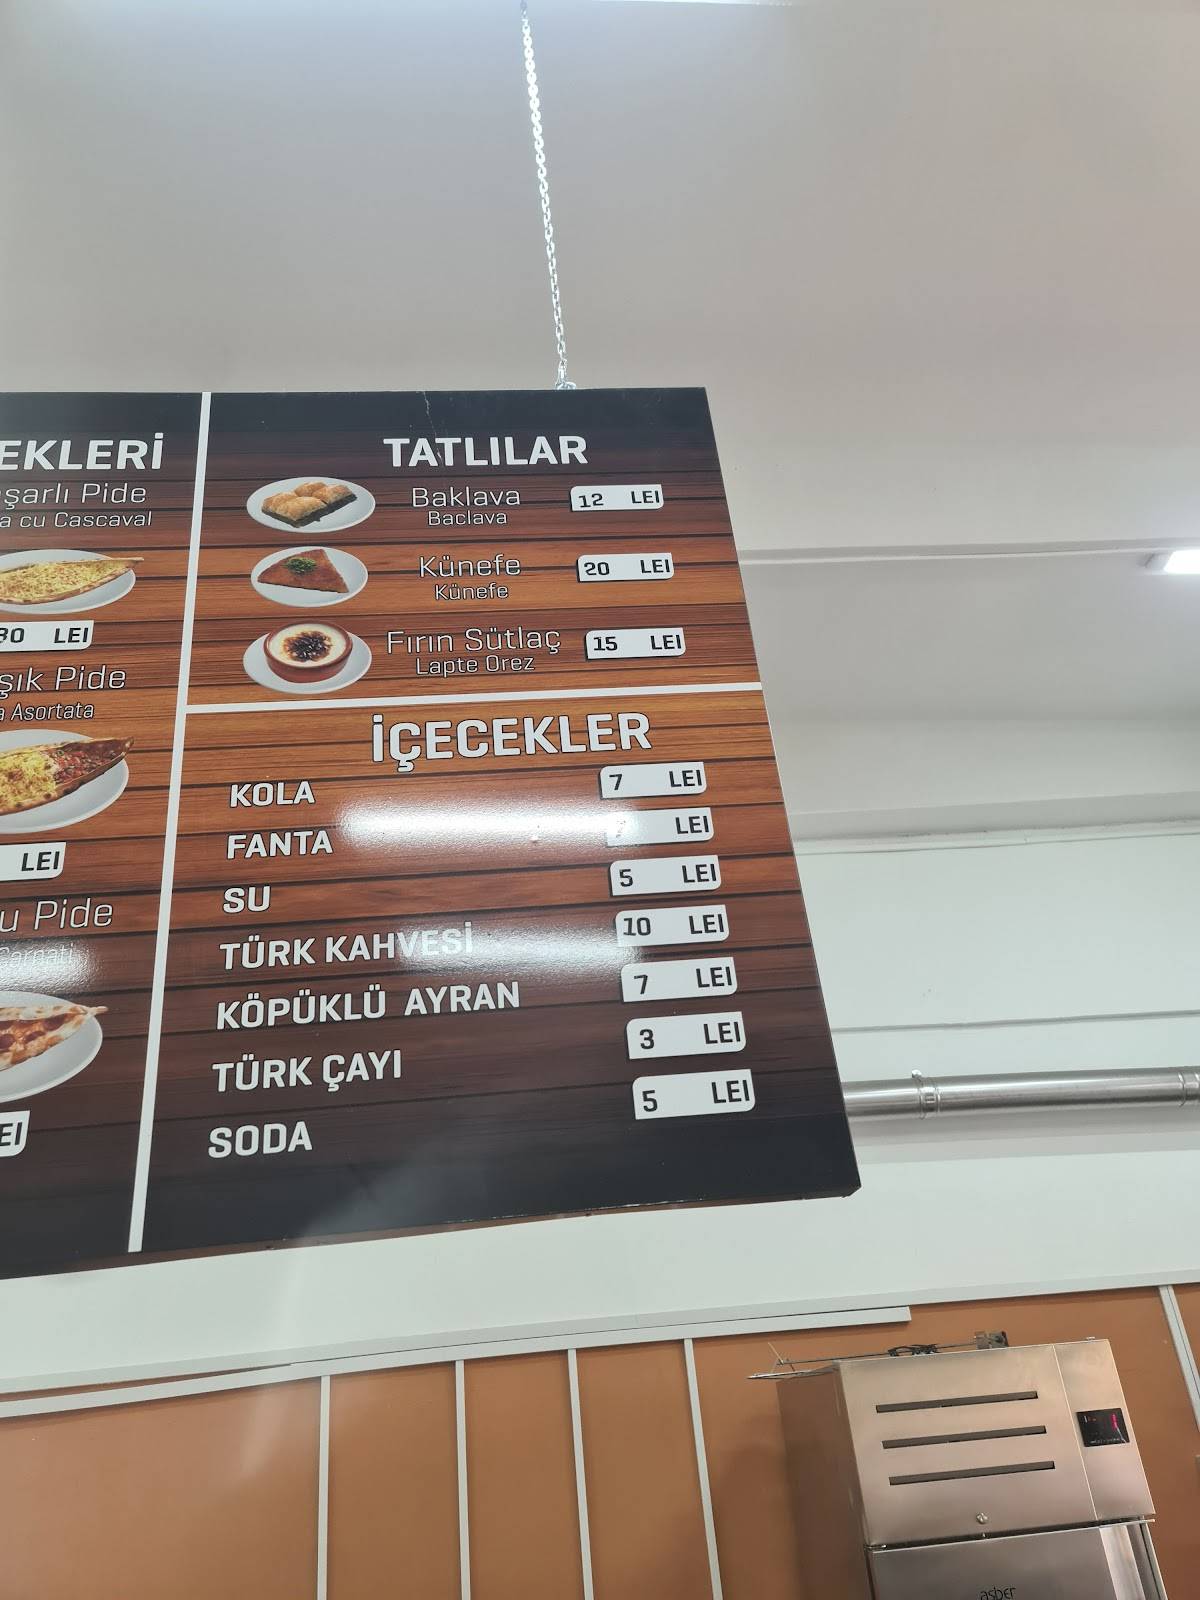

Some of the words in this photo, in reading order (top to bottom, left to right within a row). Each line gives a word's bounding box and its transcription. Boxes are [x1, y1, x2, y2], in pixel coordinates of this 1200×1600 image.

[0, 432, 164, 470] EKLERİ
[383, 435, 588, 467] TATLILAR
[0, 482, 69, 510] şarlı
[81, 482, 147, 503] Pide
[412, 486, 521, 508] Baklava
[578, 493, 604, 508] 12
[631, 490, 660, 505] LEI
[20, 516, 46, 528] cu
[54, 511, 152, 528] Cascaval
[428, 510, 508, 526] Baclava
[419, 554, 521, 578] Künefe
[583, 561, 610, 576] 20
[640, 559, 670, 574] LEI
[434, 583, 509, 600] Künefe
[54, 627, 89, 644] LEI
[386, 631, 454, 654] Fırın
[464, 626, 561, 654] Sütlaç
[593, 636, 618, 651] 15
[650, 634, 682, 650] LEI
[416, 656, 478, 678] Lapte
[486, 654, 535, 672] Orez
[0, 666, 44, 700] şık
[55, 664, 127, 691] Pide
[11, 702, 95, 722] Asortata
[371, 712, 652, 773] İÇECEKLER
[229, 780, 316, 808] KOLA
[609, 773, 623, 791] 7
[669, 769, 703, 788] LEI
[675, 815, 709, 835] LEI
[226, 830, 334, 860] FANTA
[21, 851, 60, 871] LEI
[619, 868, 634, 888] 5
[682, 863, 717, 884] LEI
[222, 885, 271, 914] SU
[33, 897, 114, 931] Pide
[623, 917, 651, 936] 10
[688, 913, 725, 935] LEI
[219, 935, 316, 971] TÜRK
[325, 921, 473, 963] KAHVESİ
[633, 974, 648, 995] 7
[696, 966, 733, 988] LEI
[216, 983, 386, 1030] KÖPÜKLÜ
[404, 981, 520, 1016] AYRAN
[639, 1029, 655, 1050] 3
[703, 1021, 741, 1044] LEI
[212, 1053, 313, 1092] TÜRK
[322, 1050, 401, 1092] ÇAYI
[642, 1089, 658, 1112] 5
[711, 1079, 750, 1104] LEI
[208, 1121, 313, 1158] SODA
